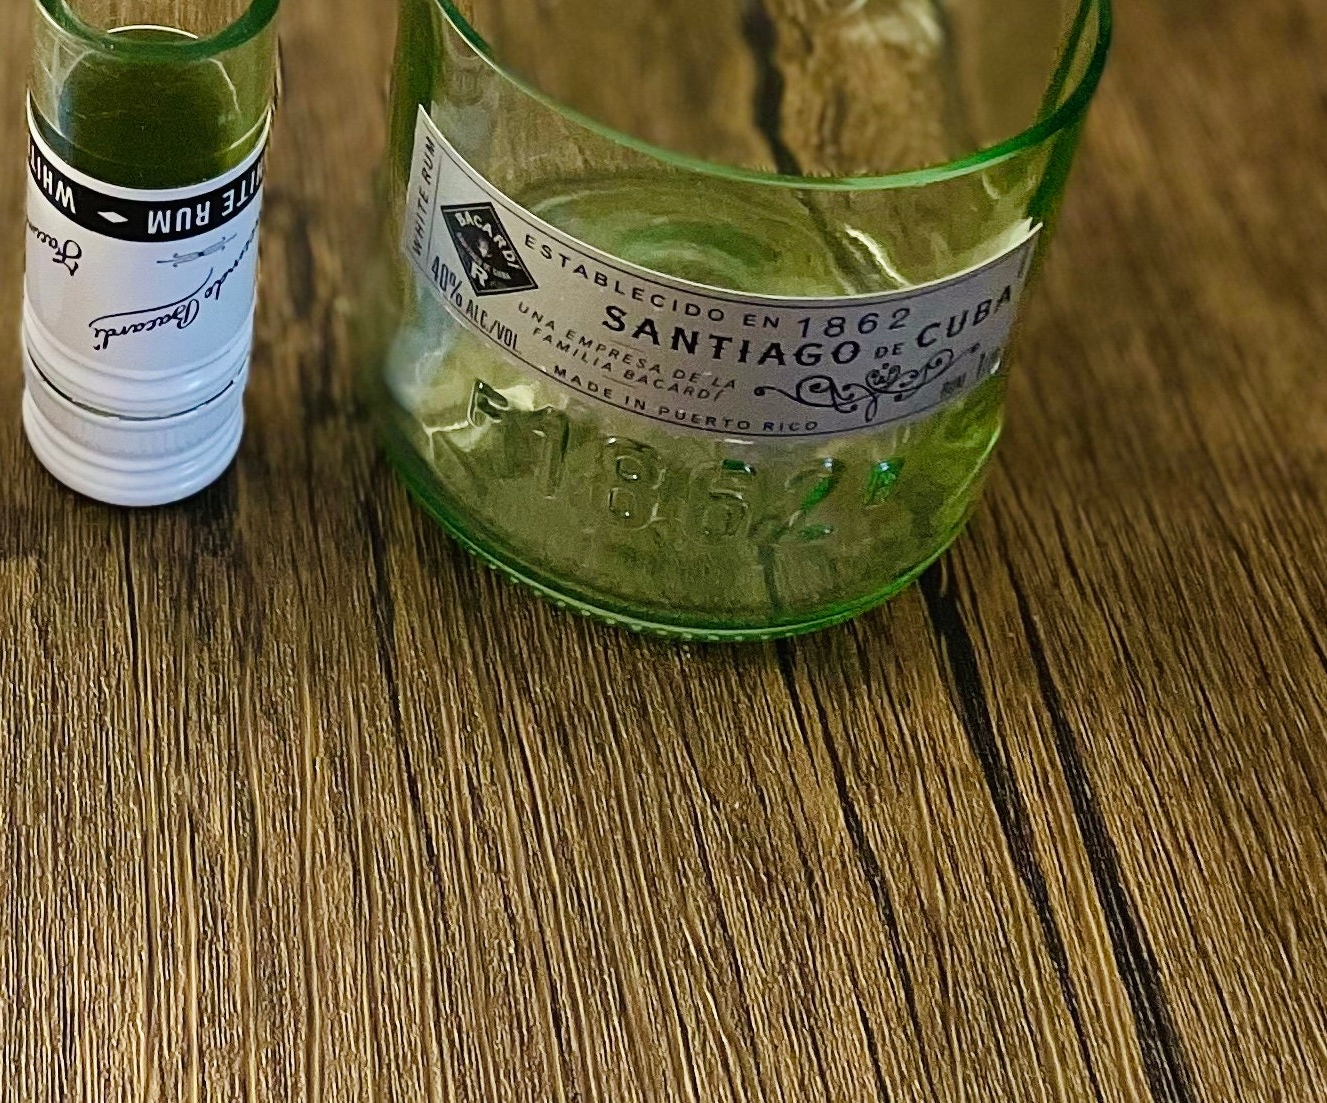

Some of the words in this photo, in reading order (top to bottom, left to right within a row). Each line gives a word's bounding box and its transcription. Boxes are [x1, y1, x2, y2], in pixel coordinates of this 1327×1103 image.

[28, 145, 76, 214] WHIT
[412, 185, 430, 257] WHITE
[421, 136, 436, 186] RUM
[148, 201, 211, 234] RUM
[431, 255, 462, 307] 40%
[524, 234, 724, 322] ESTABLECIDO
[743, 313, 780, 328] EN
[797, 307, 910, 338] 1862
[518, 301, 555, 331] UNA
[566, 328, 662, 374] EMPRESA
[672, 368, 701, 384] DE
[711, 377, 735, 389] LA
[532, 327, 613, 373] FAMILIA
[602, 305, 861, 367] SANTIAGO
[874, 342, 905, 360] DE
[915, 284, 1012, 348] CUBA
[553, 364, 614, 399] MADE
[625, 395, 647, 411] IN
[658, 406, 751, 431] PUERTO
[762, 420, 818, 432] RICO
